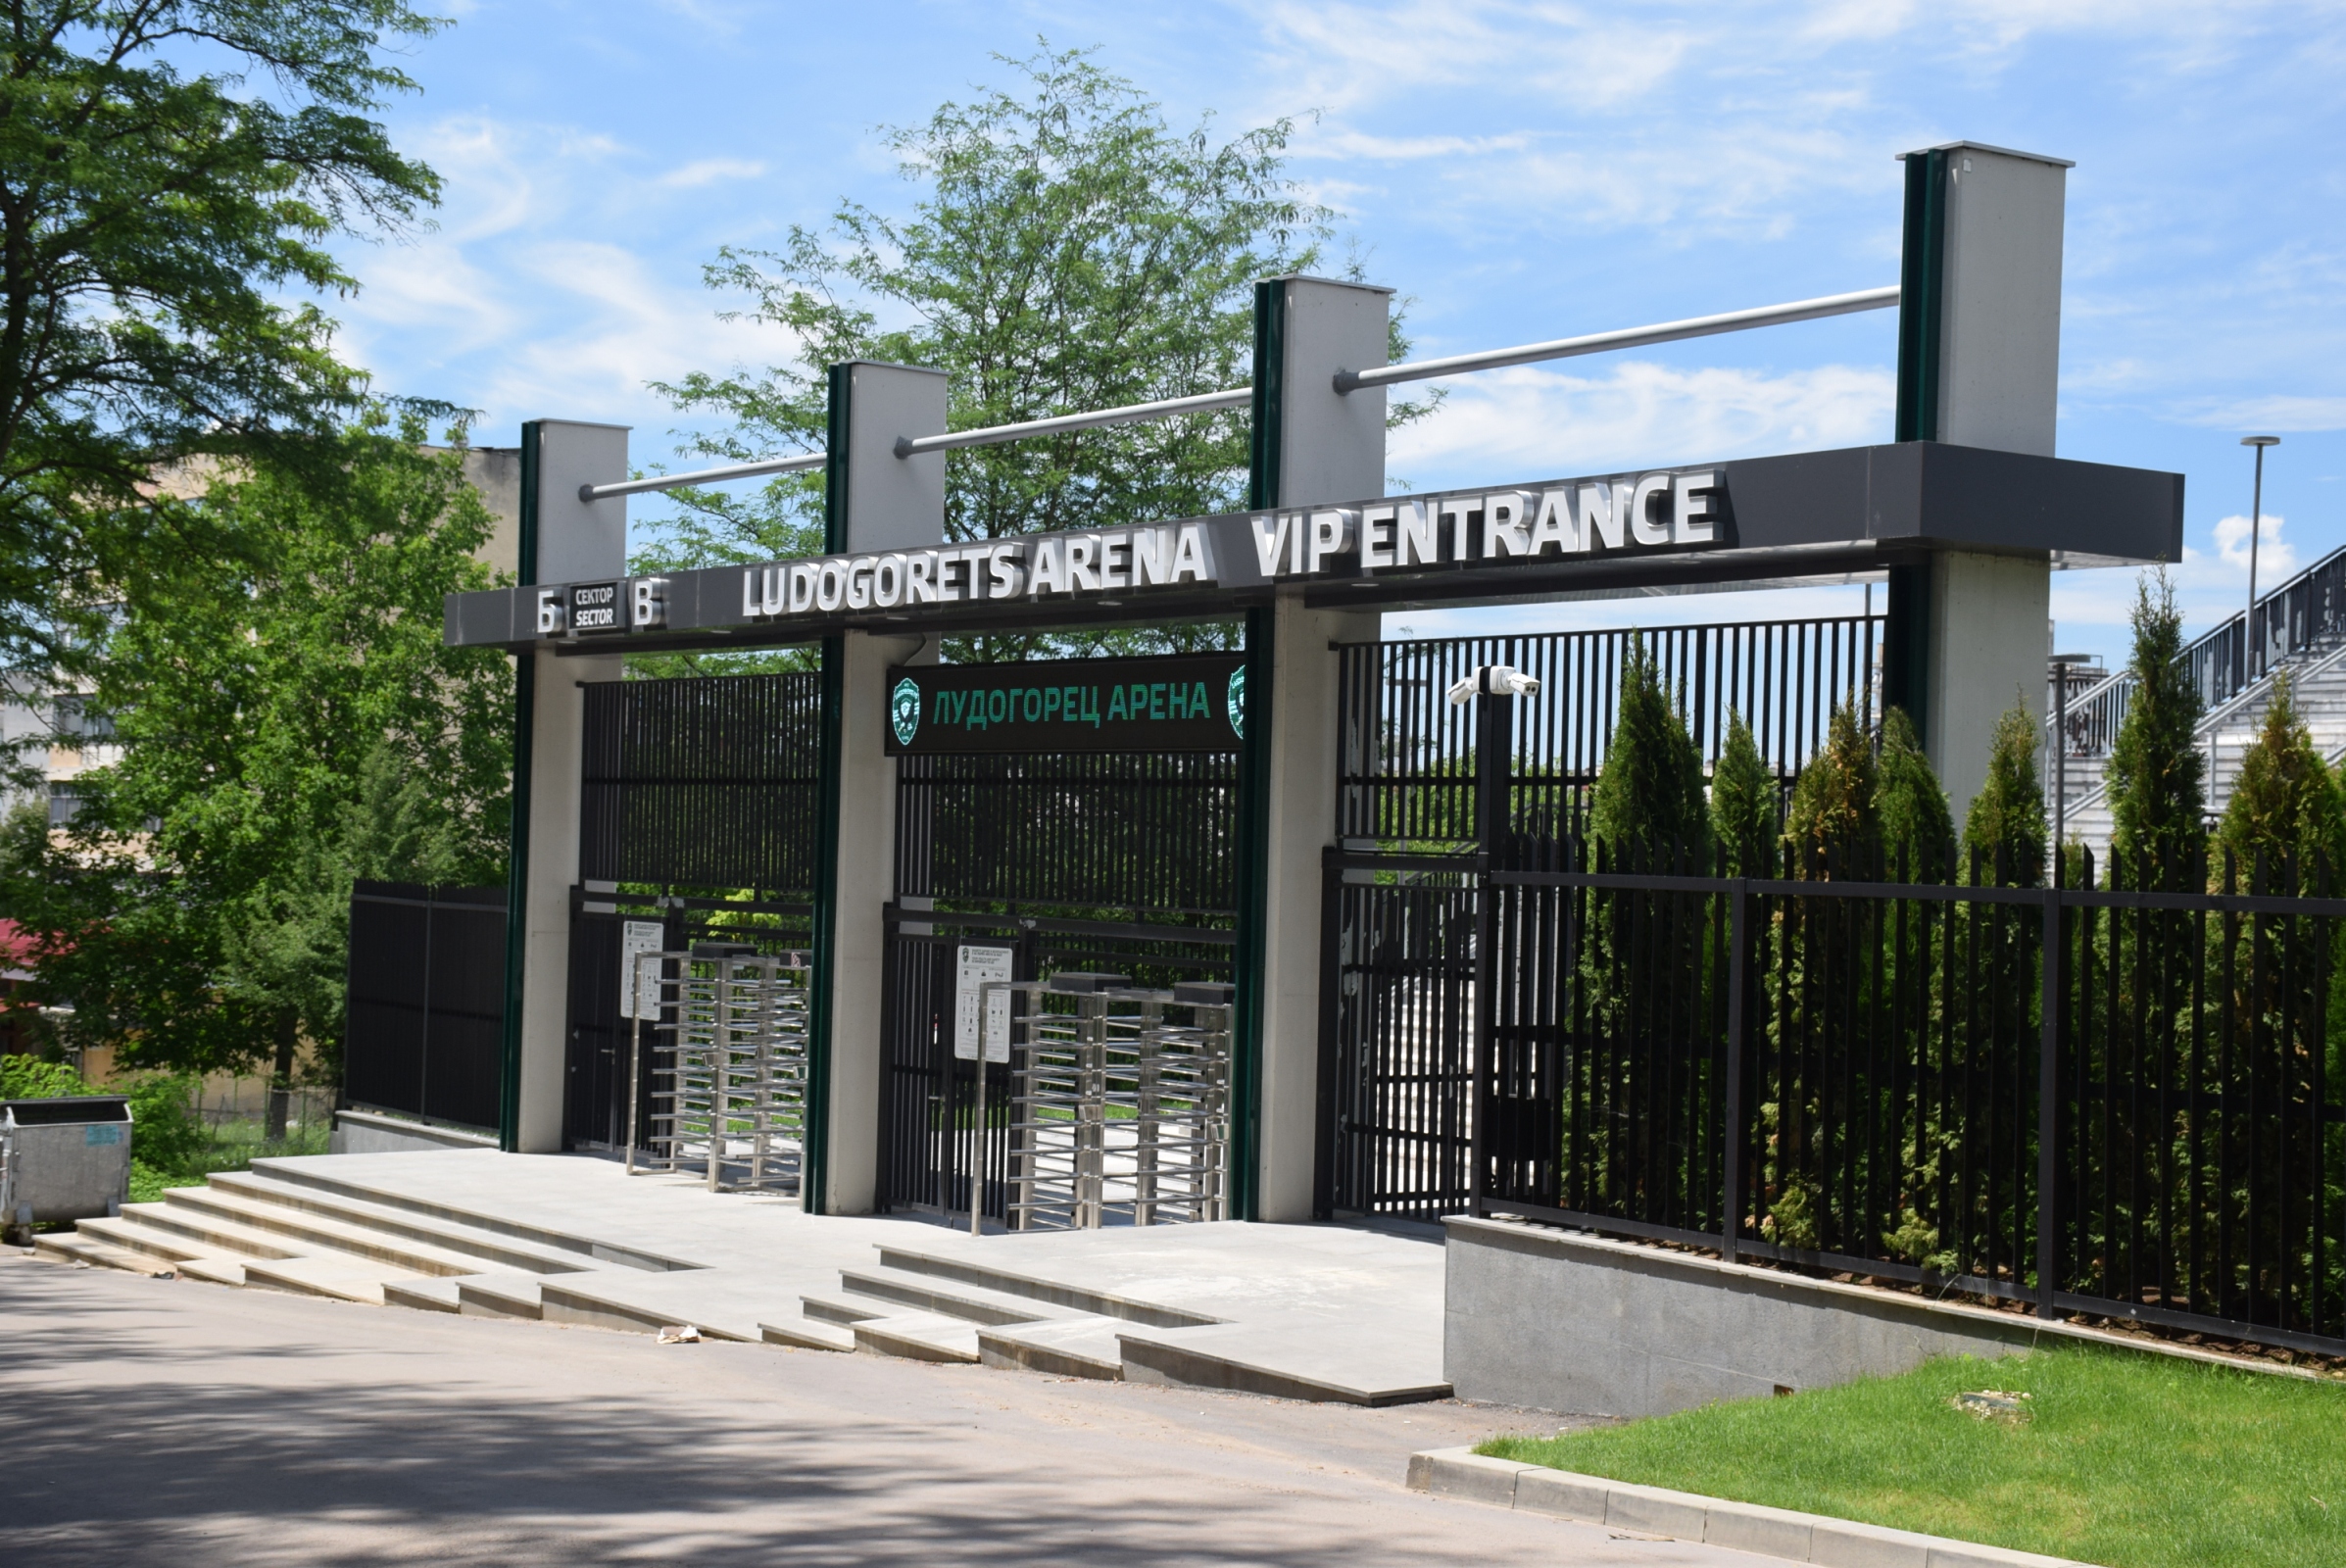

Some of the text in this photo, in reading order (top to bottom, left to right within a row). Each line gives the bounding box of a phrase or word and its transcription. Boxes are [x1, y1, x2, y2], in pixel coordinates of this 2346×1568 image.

[1250, 469, 1719, 577] VIP ENTRANCE
[743, 523, 1208, 616] LUDOGORETS ARENA
[537, 587, 613, 633] Б СЕКТОР
[575, 608, 613, 626] SECTOR
[933, 682, 1211, 731] ЛУДОГОРЕЦ АРЕНА
